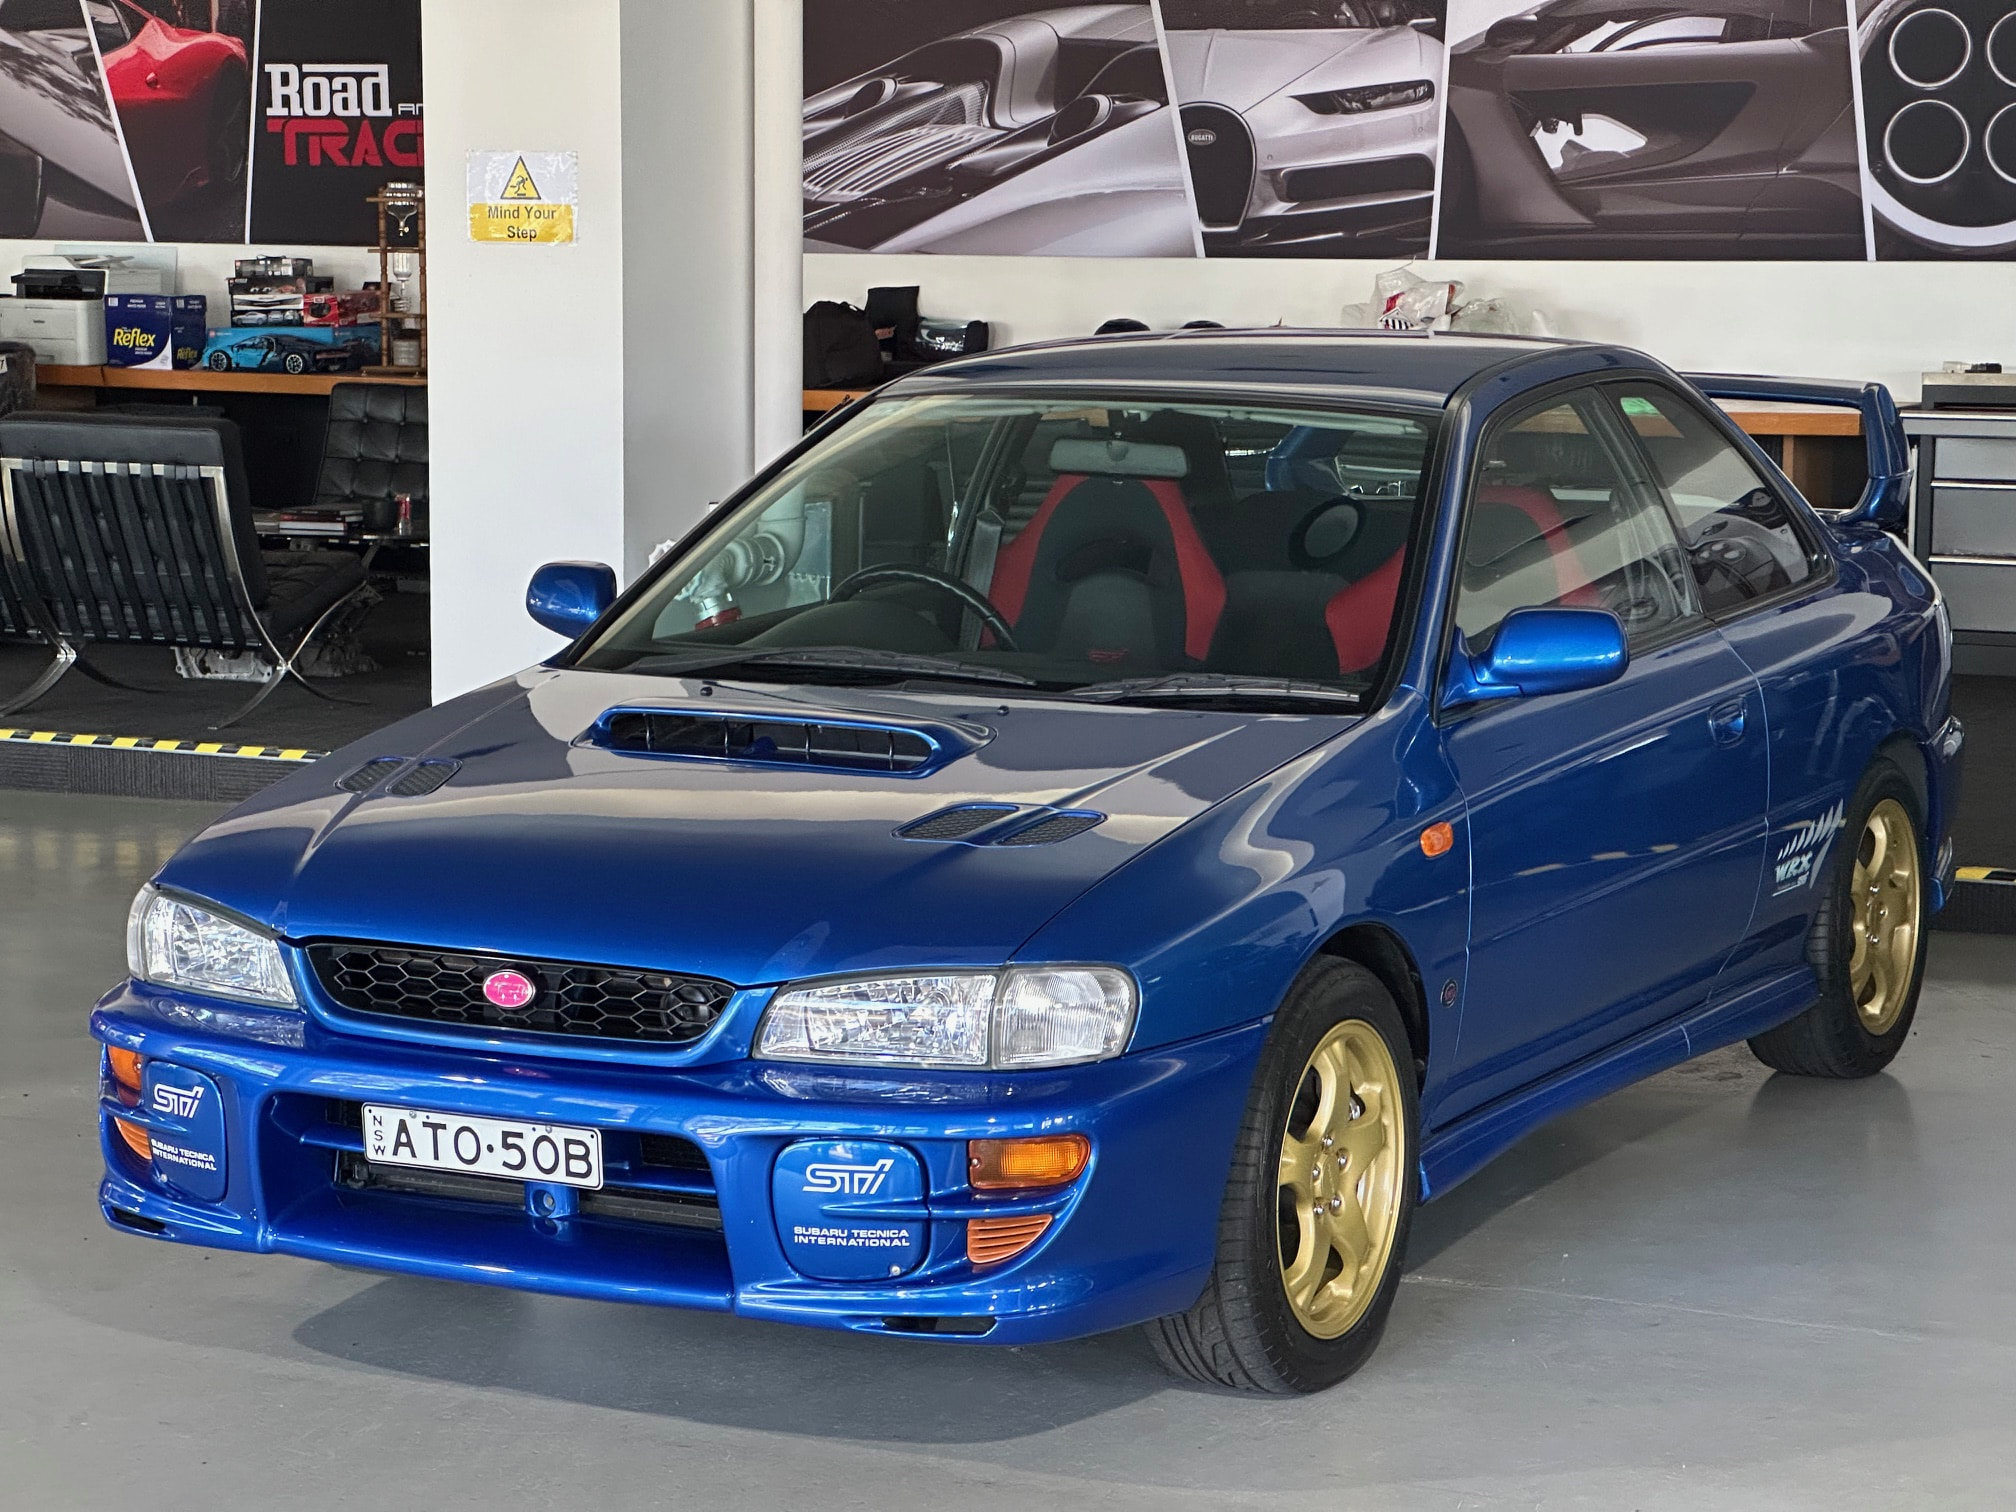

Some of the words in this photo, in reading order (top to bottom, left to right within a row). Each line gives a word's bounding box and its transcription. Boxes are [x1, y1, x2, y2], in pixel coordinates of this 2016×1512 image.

[264, 63, 392, 116] Road
[266, 118, 424, 167] TRAC
[487, 206, 520, 219] Mind
[524, 206, 556, 219] Your
[507, 225, 537, 242] Step
[113, 328, 156, 348] Reflex
[151, 1138, 178, 1155] SUBARU
[179, 1148, 215, 1163] TECNICA
[152, 1146, 216, 1171] INTERNATIONAL
[793, 1226, 848, 1237] SUBARU
[851, 1229, 909, 1238] TECNICA
[794, 1235, 910, 1247] INTERNATIONAL
